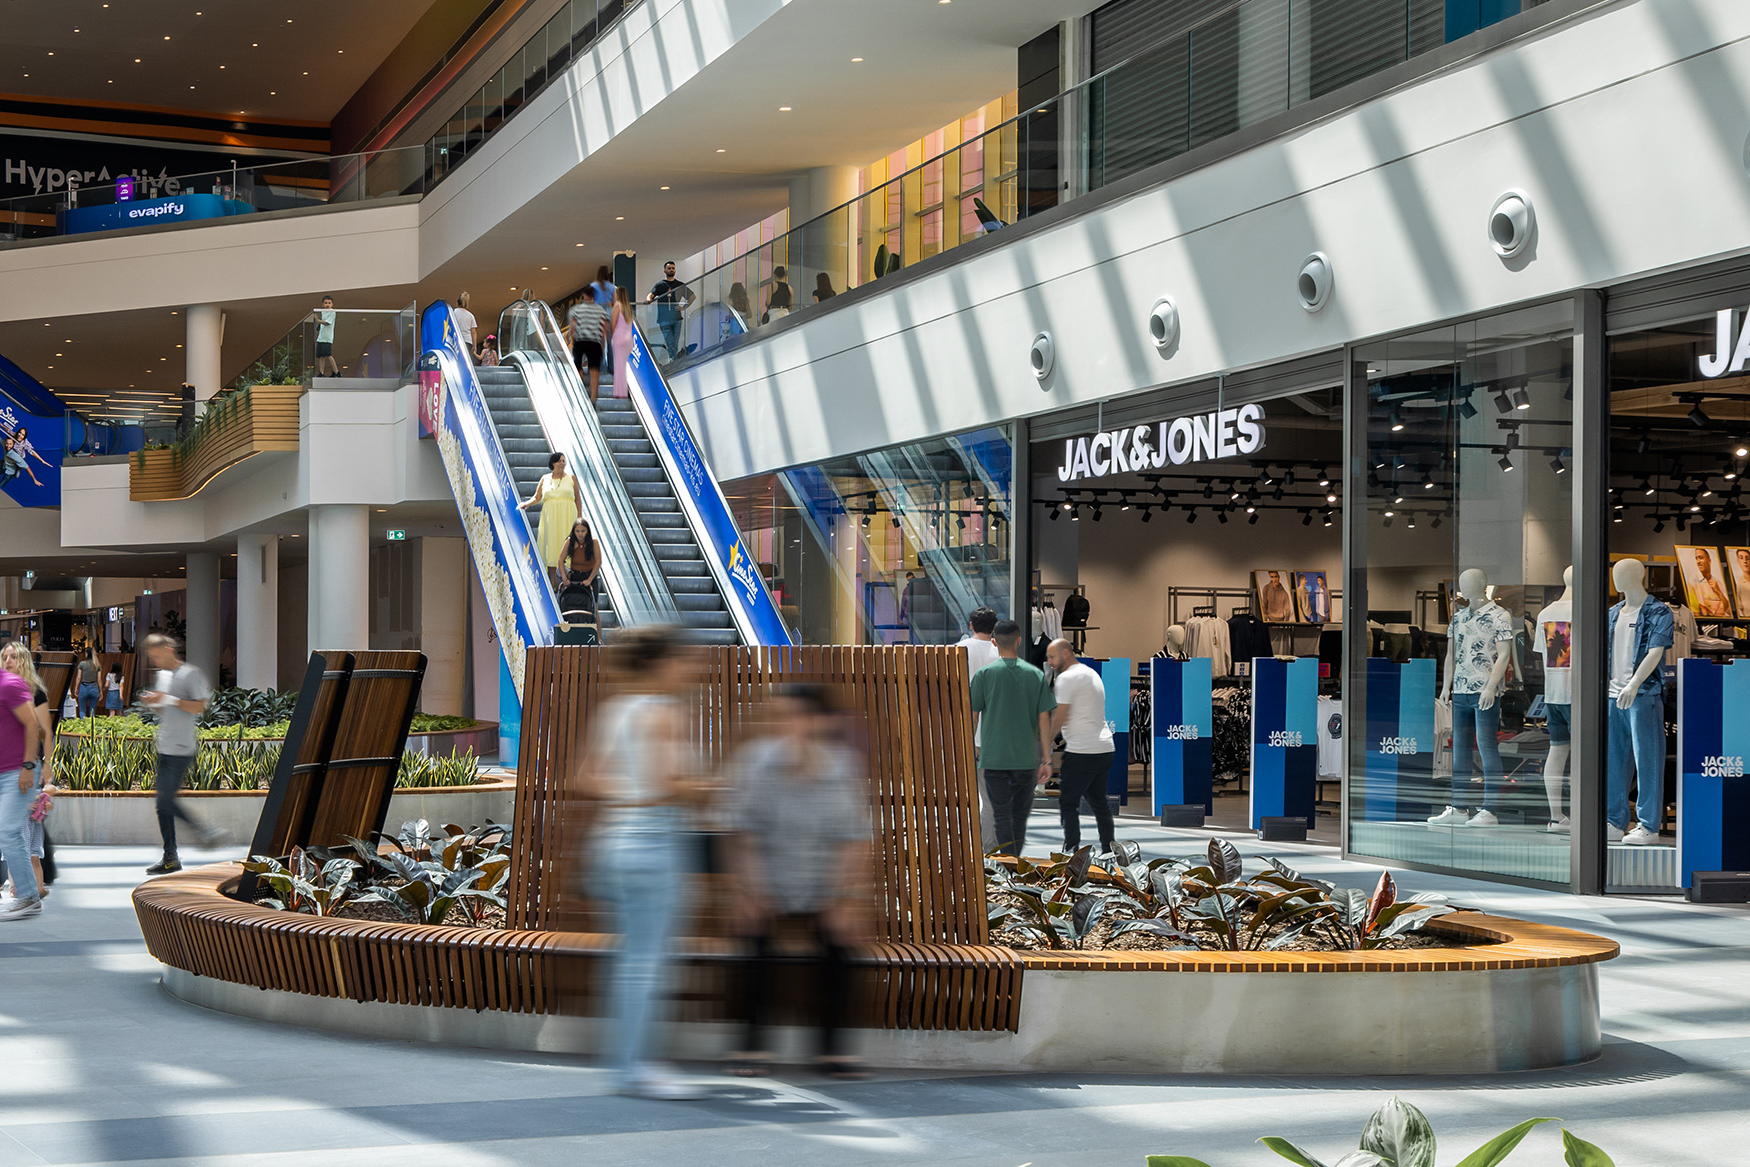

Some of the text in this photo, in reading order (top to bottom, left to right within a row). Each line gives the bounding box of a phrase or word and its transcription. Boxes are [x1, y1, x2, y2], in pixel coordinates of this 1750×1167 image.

[5, 159, 181, 197] HyperAtive
[128, 202, 184, 219] evapify
[1058, 404, 1266, 482] JACK&JONES
[672, 417, 686, 447] STAR
[683, 439, 705, 486] CINEMAS
[1167, 724, 1199, 733] JACK&
[1167, 731, 1199, 740] JONES
[1268, 730, 1303, 740] JACK&
[1268, 738, 1303, 748] JONES
[1379, 736, 1418, 746] JACK&
[1379, 745, 1418, 755] JONES
[1701, 756, 1744, 767] JACK&
[1701, 766, 1744, 778] JONES
